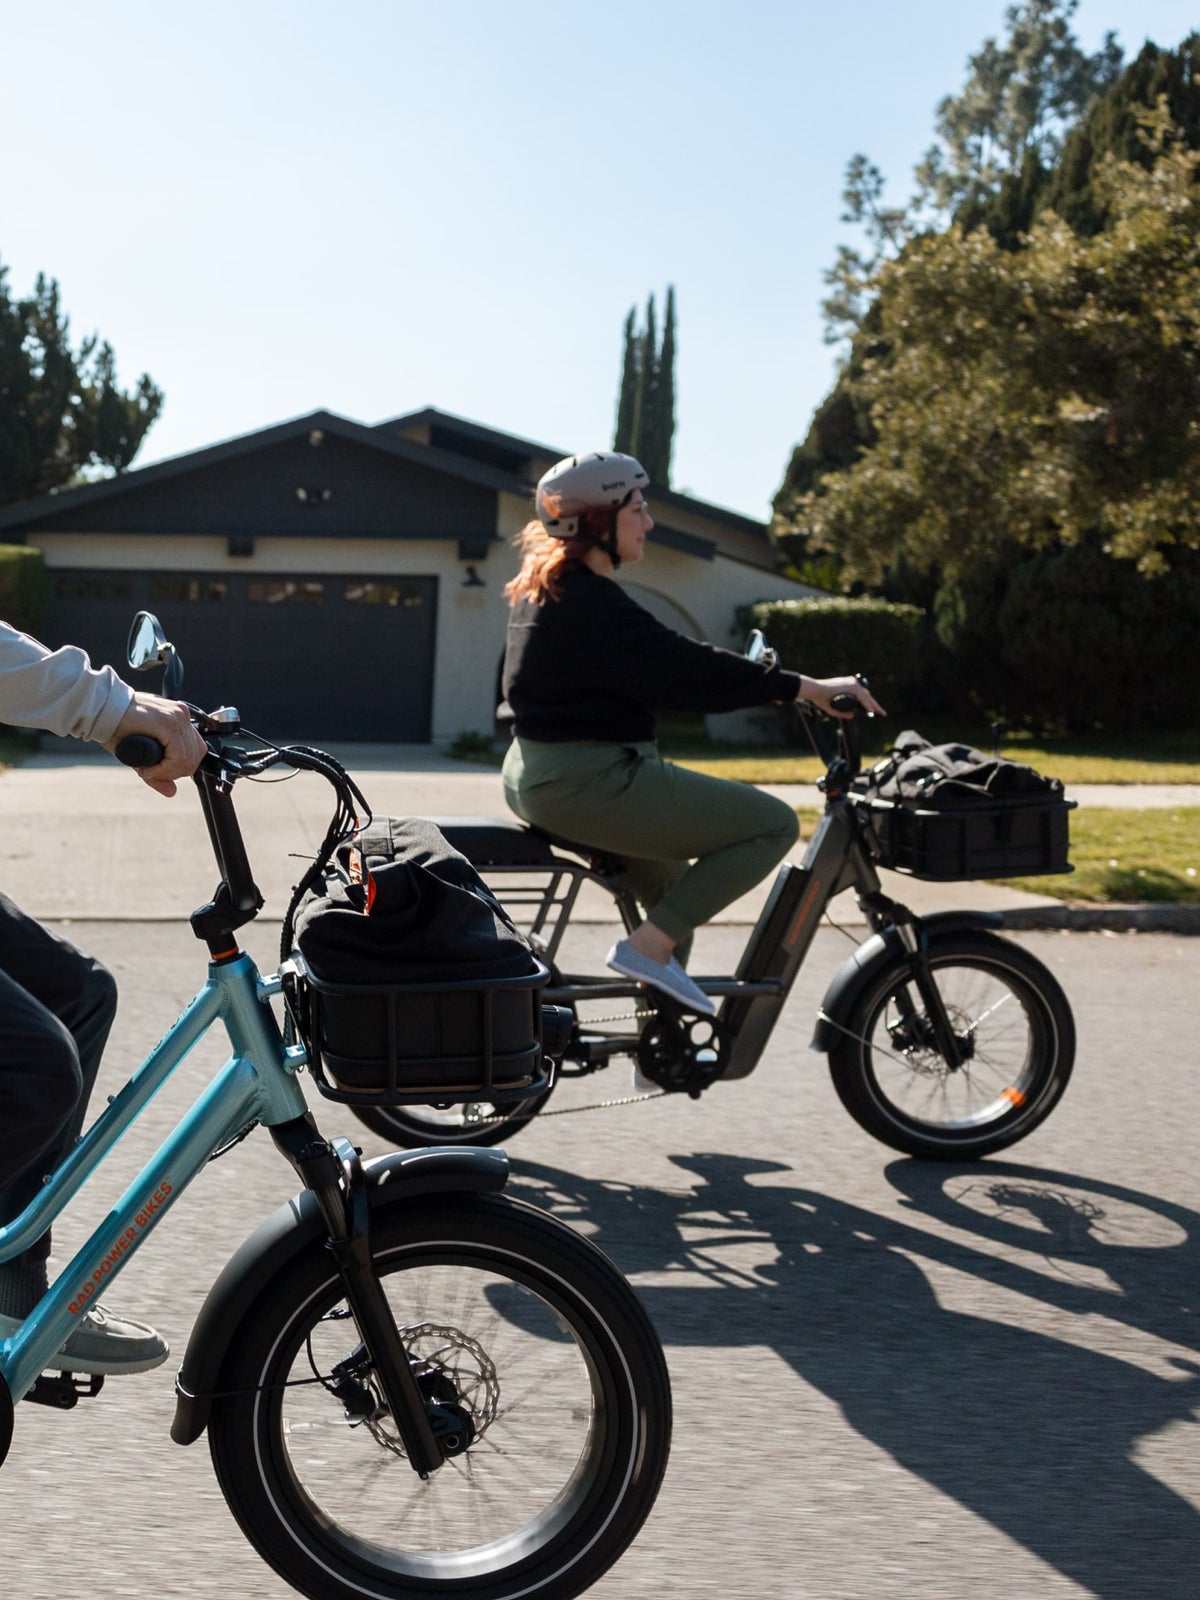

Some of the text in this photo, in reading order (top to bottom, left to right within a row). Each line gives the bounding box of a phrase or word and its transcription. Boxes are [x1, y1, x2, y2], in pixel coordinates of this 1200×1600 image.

[67, 1181, 173, 1316] RAD POWER BIKES
